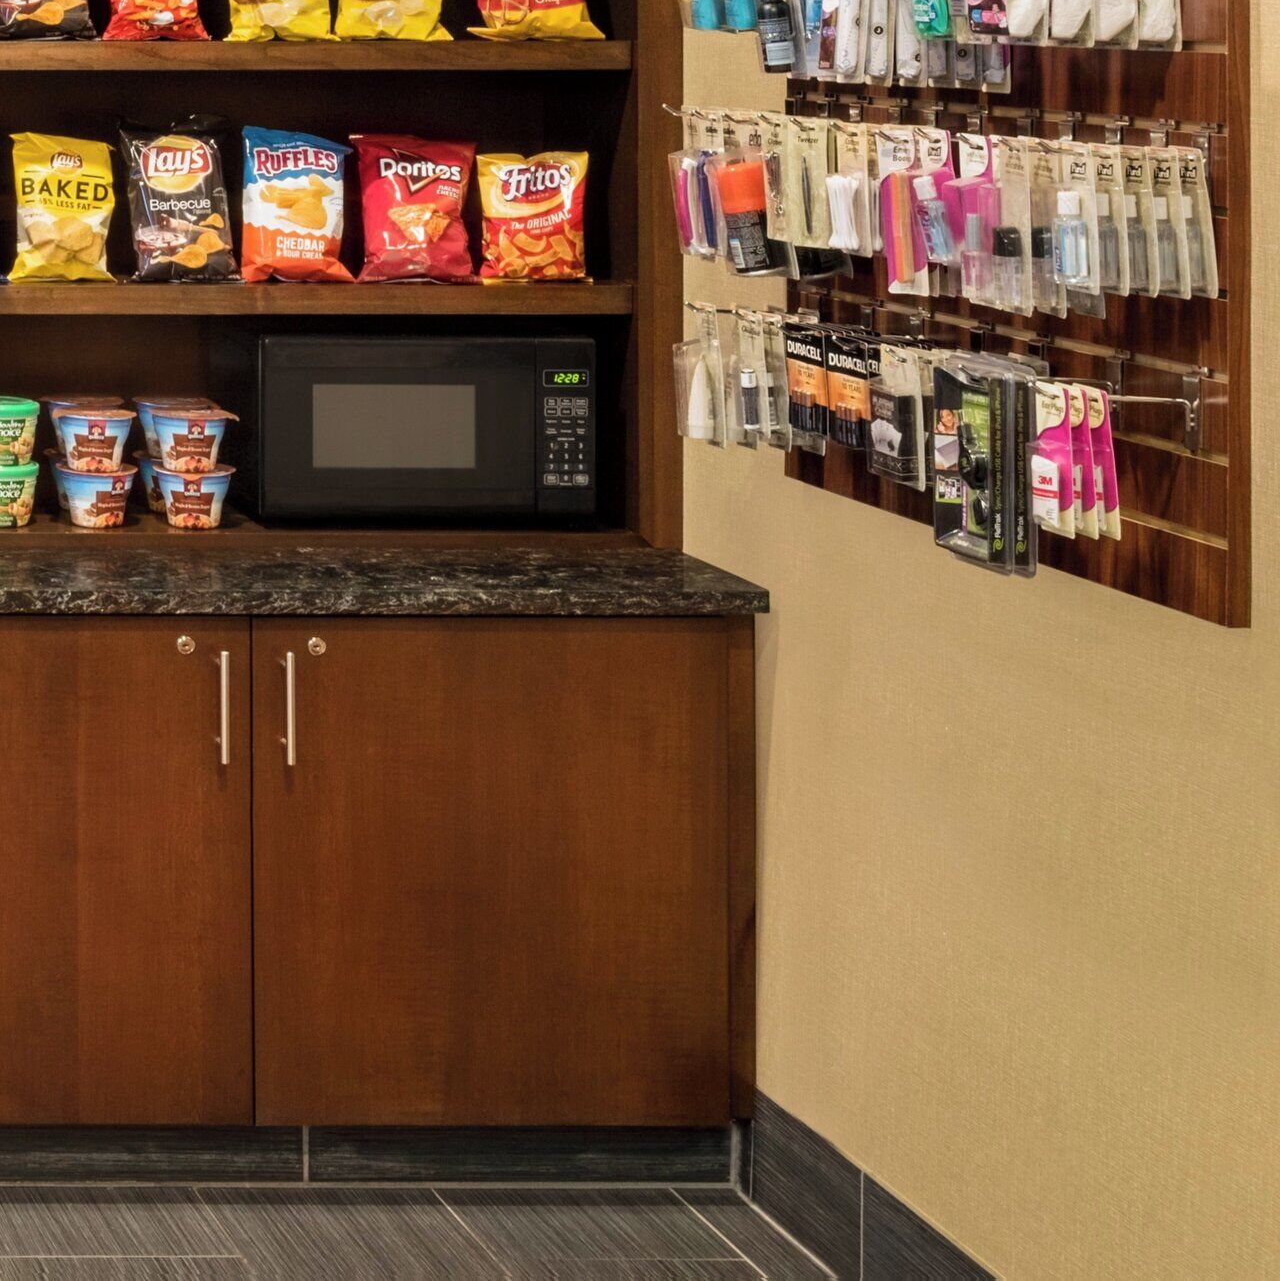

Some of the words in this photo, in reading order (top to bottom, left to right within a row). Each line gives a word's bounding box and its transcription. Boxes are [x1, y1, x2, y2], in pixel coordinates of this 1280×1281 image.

[50, 153, 81, 169] Lay's
[147, 143, 205, 178] Lay's
[254, 147, 338, 175] RUFFLES
[380, 160, 462, 182] Doritos
[21, 177, 109, 203] BAKED
[499, 165, 572, 200] Fritos
[149, 197, 211, 211] Barbecue
[276, 237, 326, 253] CHEDDAR
[787, 340, 822, 361] DURACELL
[828, 352, 867, 374] DURACELL
[1037, 475, 1053, 486] 3M
